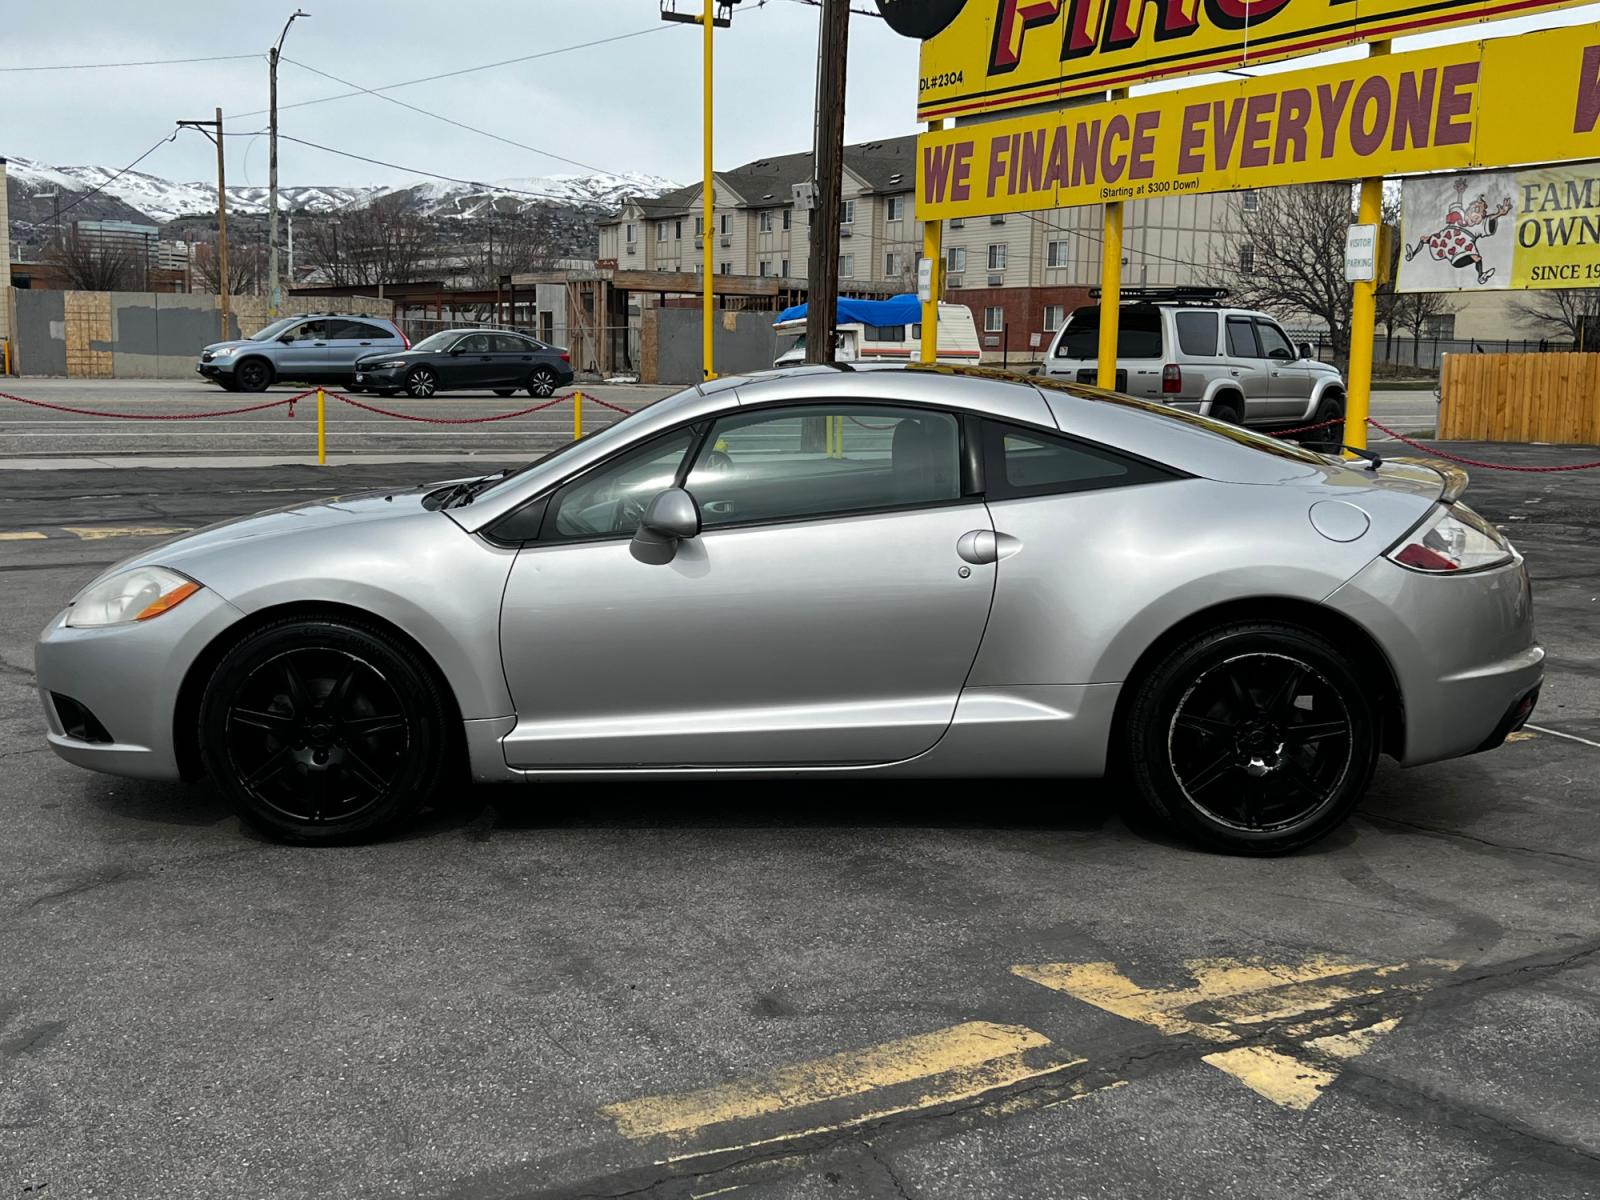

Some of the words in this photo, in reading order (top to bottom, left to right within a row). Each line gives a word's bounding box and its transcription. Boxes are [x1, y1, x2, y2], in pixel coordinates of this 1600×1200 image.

[919, 70, 963, 91] DL#2304
[923, 141, 974, 204] WE
[986, 110, 1160, 198] FINANCE
[1177, 61, 1480, 175] EVERYONE
[1100, 187, 1134, 199] (Starting
[1136, 185, 1145, 195] at
[1148, 181, 1170, 193] $300
[1173, 178, 1200, 190] Down)
[1521, 178, 1600, 213] FAM
[1531, 264, 1581, 281] SINCE
